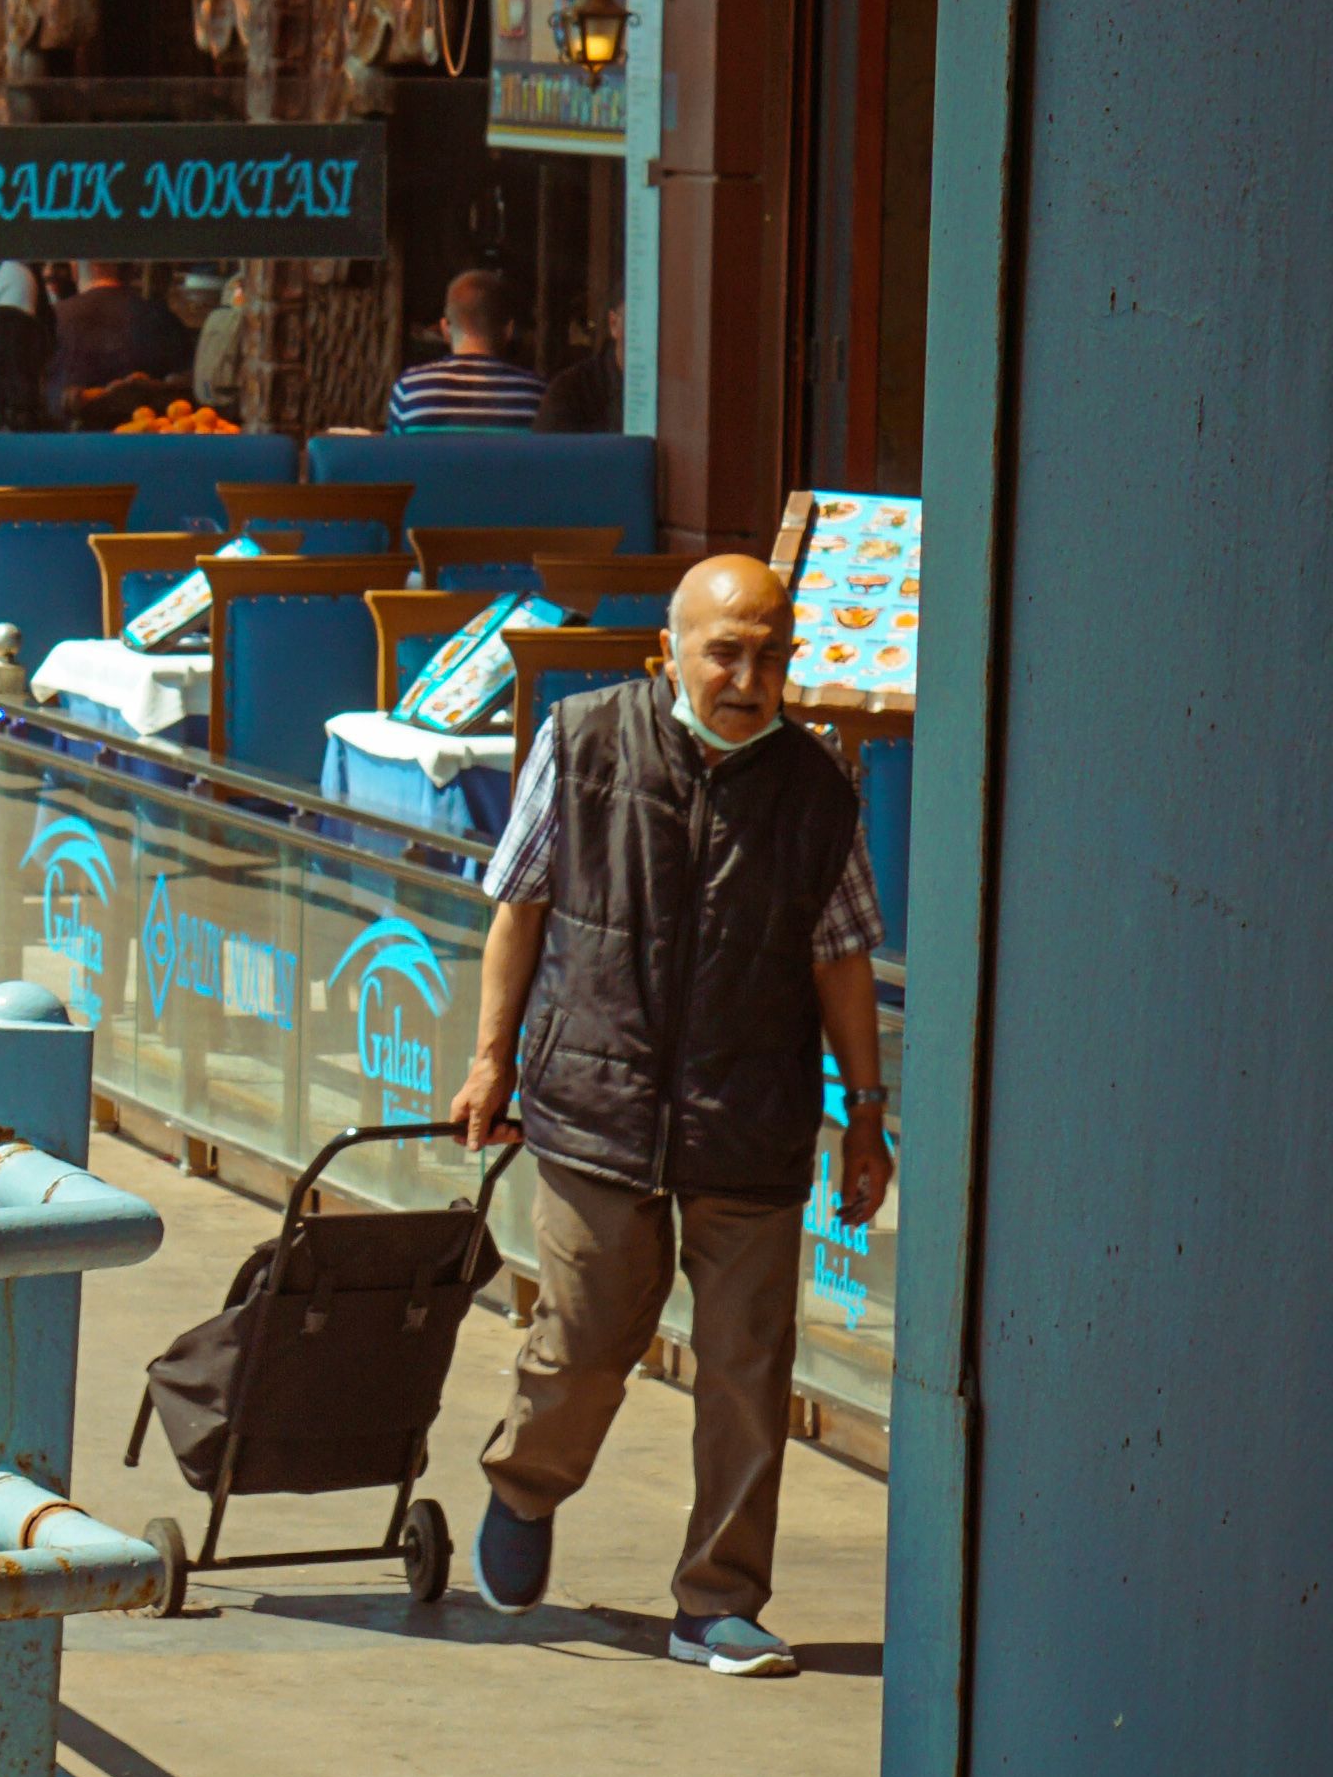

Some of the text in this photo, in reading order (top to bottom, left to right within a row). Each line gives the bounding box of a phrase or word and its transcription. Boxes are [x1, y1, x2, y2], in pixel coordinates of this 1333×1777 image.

[138, 152, 360, 220] NOKTASI
[357, 975, 434, 1095] Galata
[814, 1242, 868, 1332] Bridge
